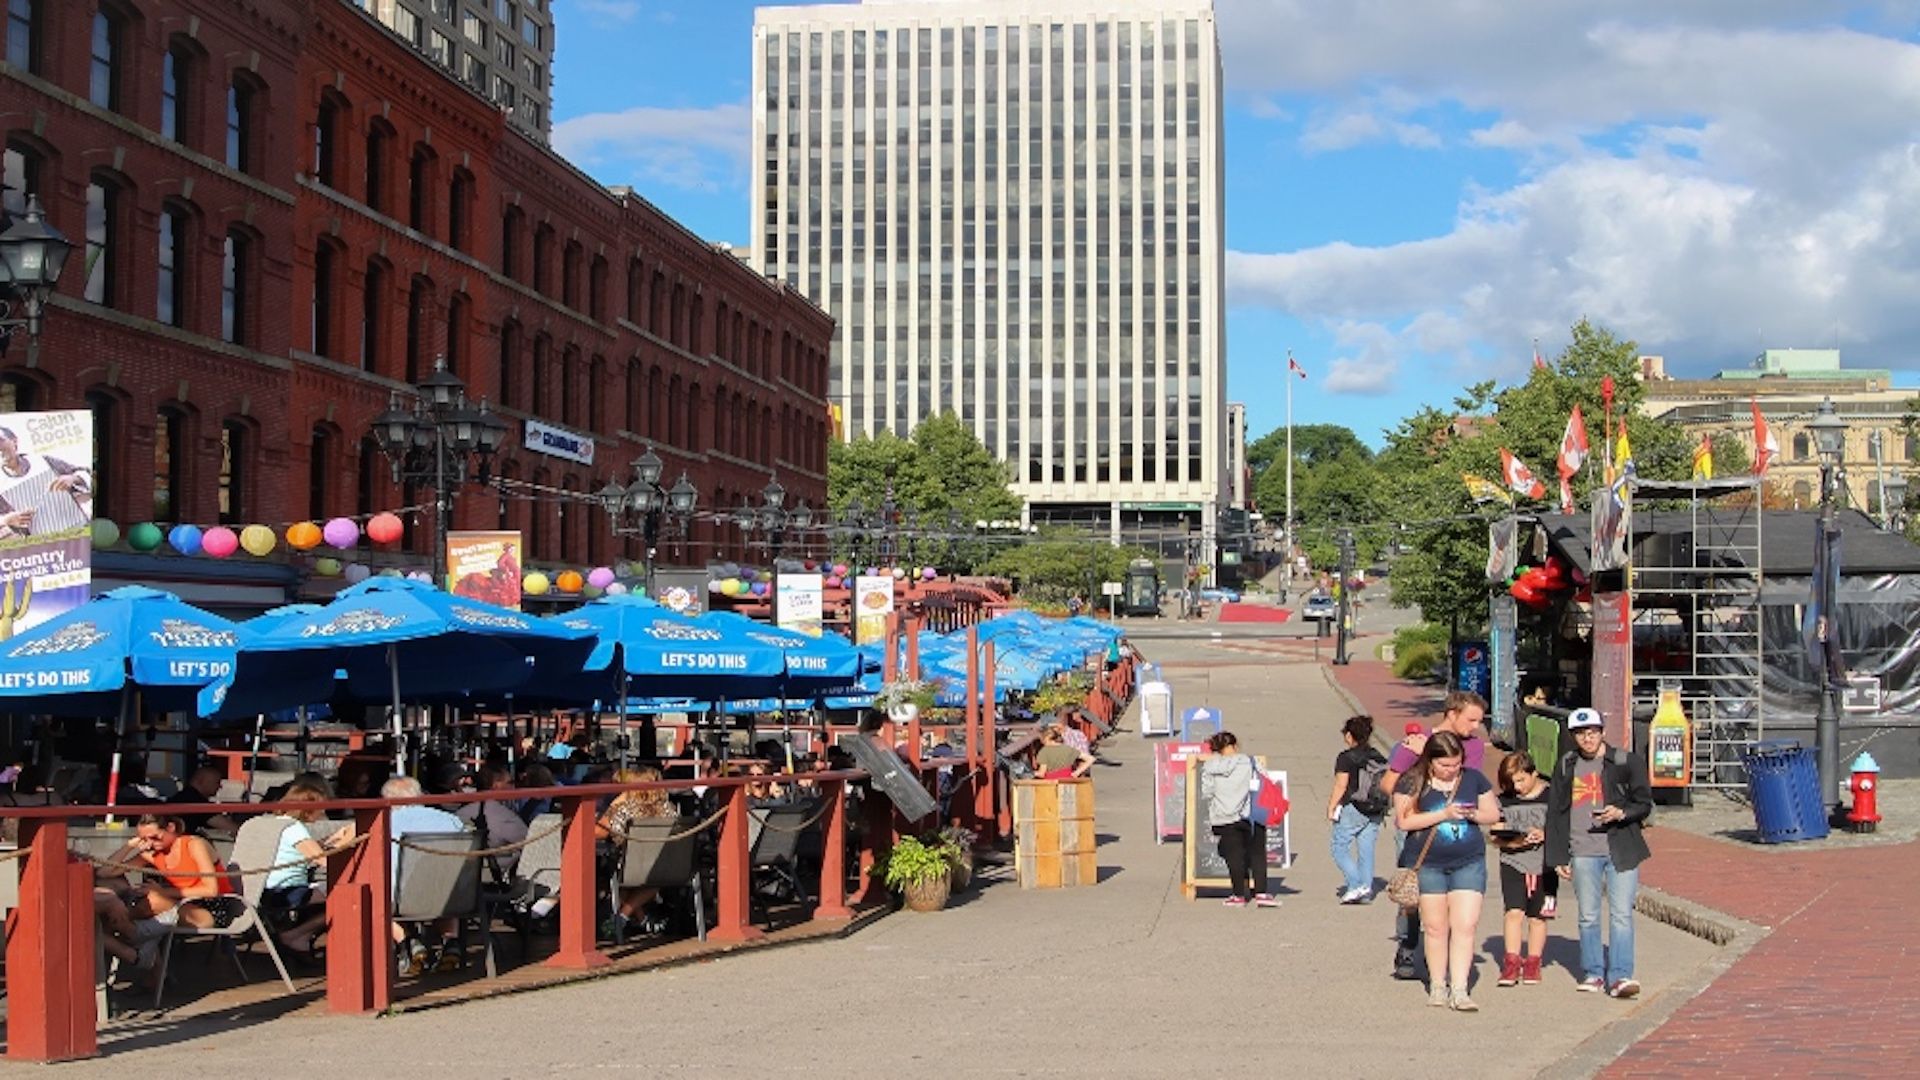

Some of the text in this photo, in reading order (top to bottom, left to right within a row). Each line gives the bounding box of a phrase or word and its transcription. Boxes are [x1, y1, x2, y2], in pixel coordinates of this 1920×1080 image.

[26, 412, 76, 432] Cajun
[31, 425, 83, 446] Roots
[1, 550, 66, 571] Country
[52, 559, 84, 574] Style
[170, 661, 230, 677] LET'S DO
[662, 652, 747, 669] LET'S DO THIS
[802, 657, 828, 669] THIS
[0, 669, 91, 688] LET'S DO THIS
